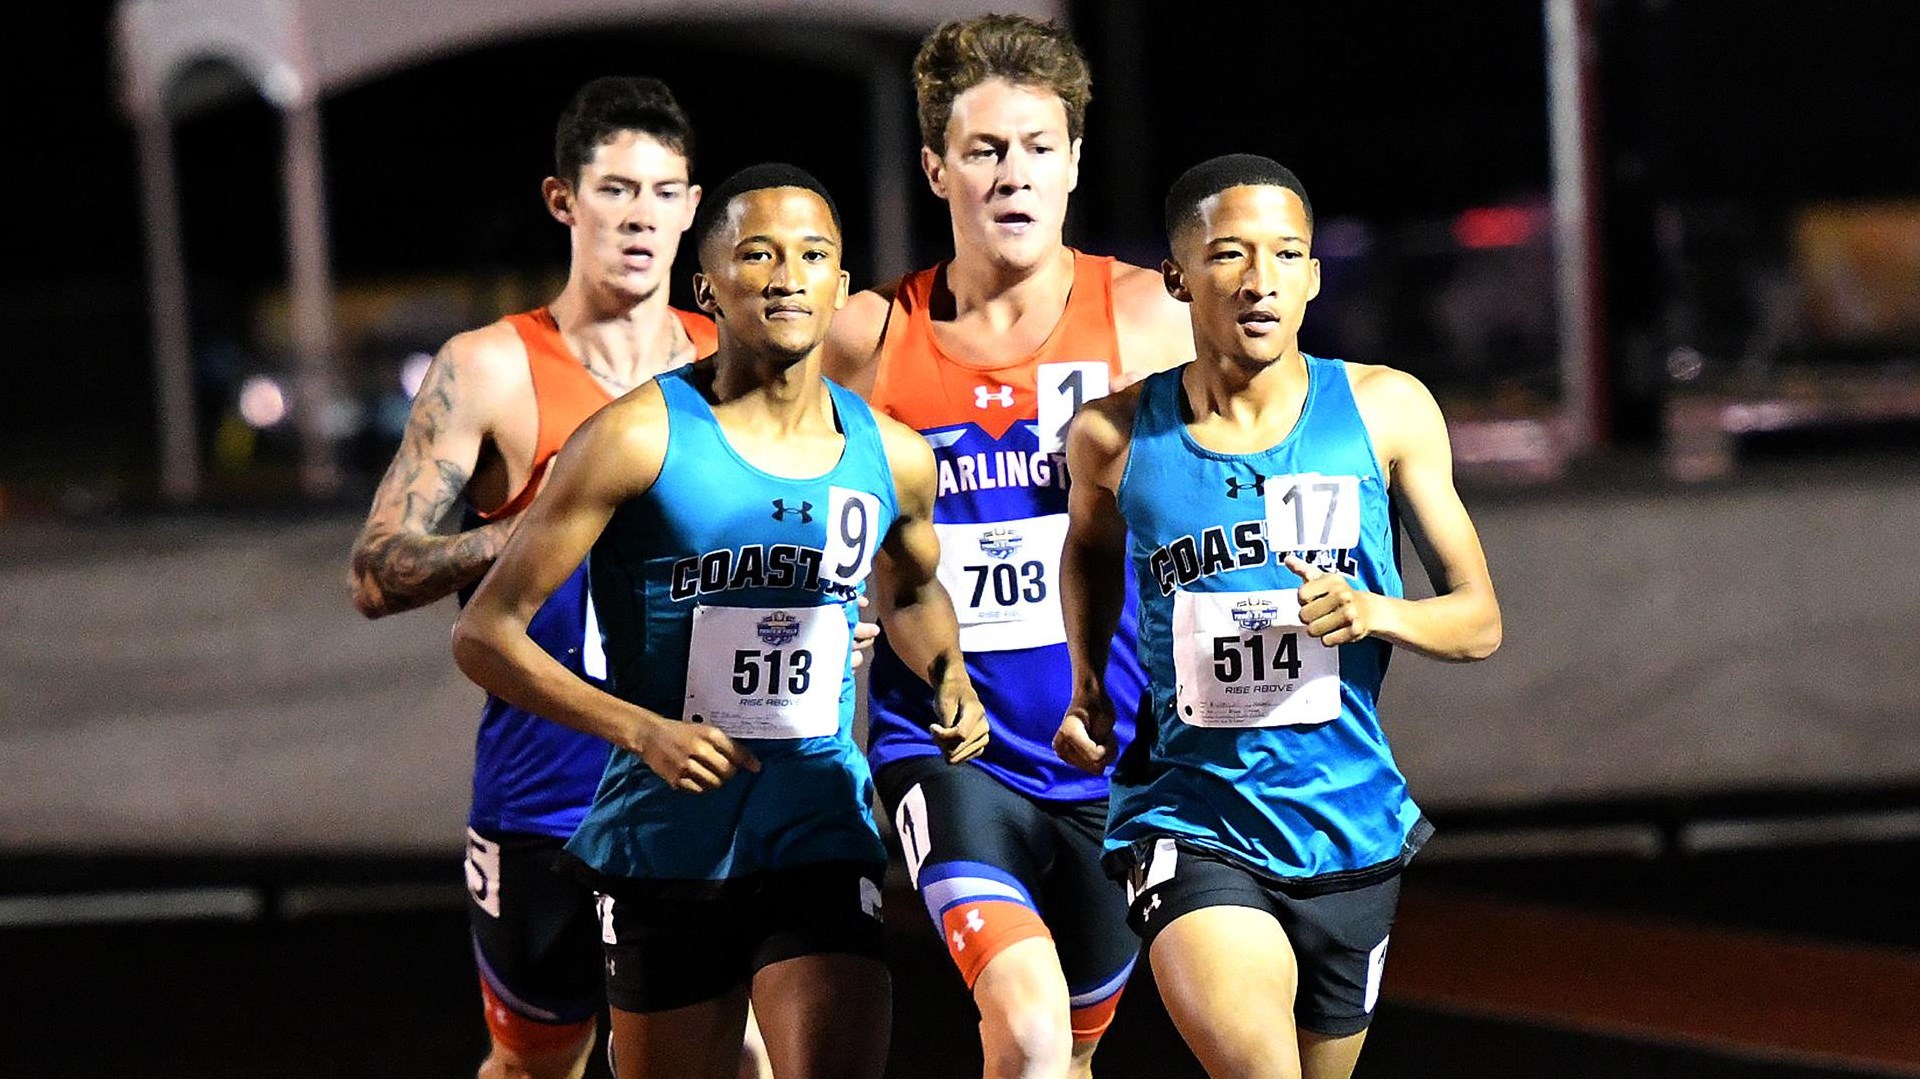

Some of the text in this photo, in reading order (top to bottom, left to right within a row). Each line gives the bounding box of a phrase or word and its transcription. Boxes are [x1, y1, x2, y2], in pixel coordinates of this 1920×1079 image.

[834, 496, 868, 579] 9
[1282, 483, 1340, 545] 17
[1150, 520, 1358, 597] COASL
[963, 560, 1046, 608] 703
[732, 649, 812, 695] 513
[1213, 633, 1302, 683] 514
[738, 698, 763, 707] RISE
[1225, 684, 1294, 694] RISE ABOVE
